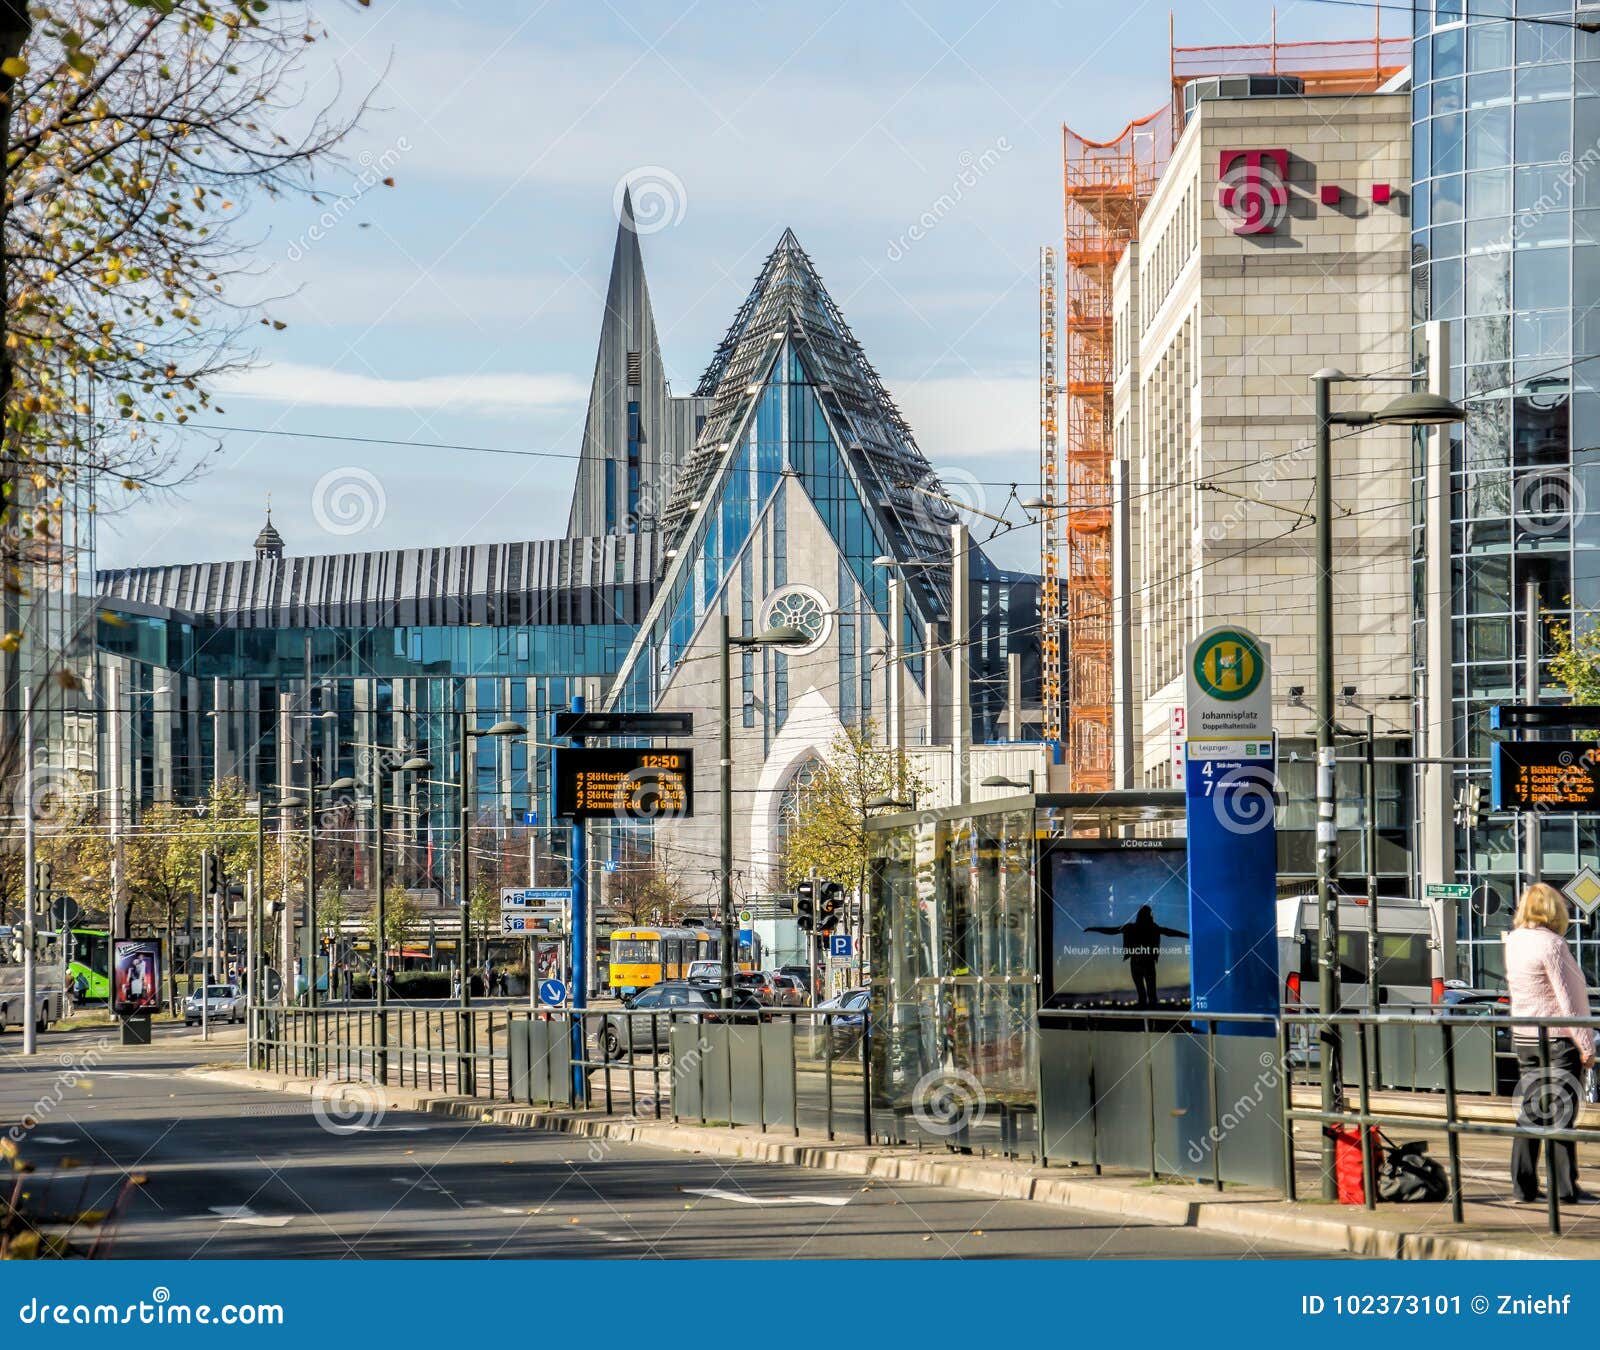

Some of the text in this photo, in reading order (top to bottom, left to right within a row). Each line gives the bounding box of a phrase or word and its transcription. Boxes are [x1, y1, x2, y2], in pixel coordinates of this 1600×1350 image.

[1214, 647, 1244, 686] H
[1202, 711, 1258, 720] Johannisplatz
[642, 755, 679, 768] 12:50
[1202, 761, 1213, 777] 4
[1520, 766, 1527, 774] 7
[586, 773, 629, 781] Stötteritz
[577, 782, 583, 790] 7
[586, 782, 641, 790] Sommerfeld
[1203, 781, 1213, 796] 7
[1576, 784, 1594, 793] Zoo
[586, 791, 629, 799] Stötteritz
[1521, 794, 1527, 802] 7
[577, 800, 583, 808] 7
[586, 800, 641, 808] Sommerfeld
[1121, 840, 1163, 848] JCDecaux
[836, 938, 846, 954] P
[1063, 945, 1090, 955] Neue
[1092, 945, 1110, 955] Zeit
[1113, 944, 1151, 955] braucht
[1152, 946, 1183, 955] neues
